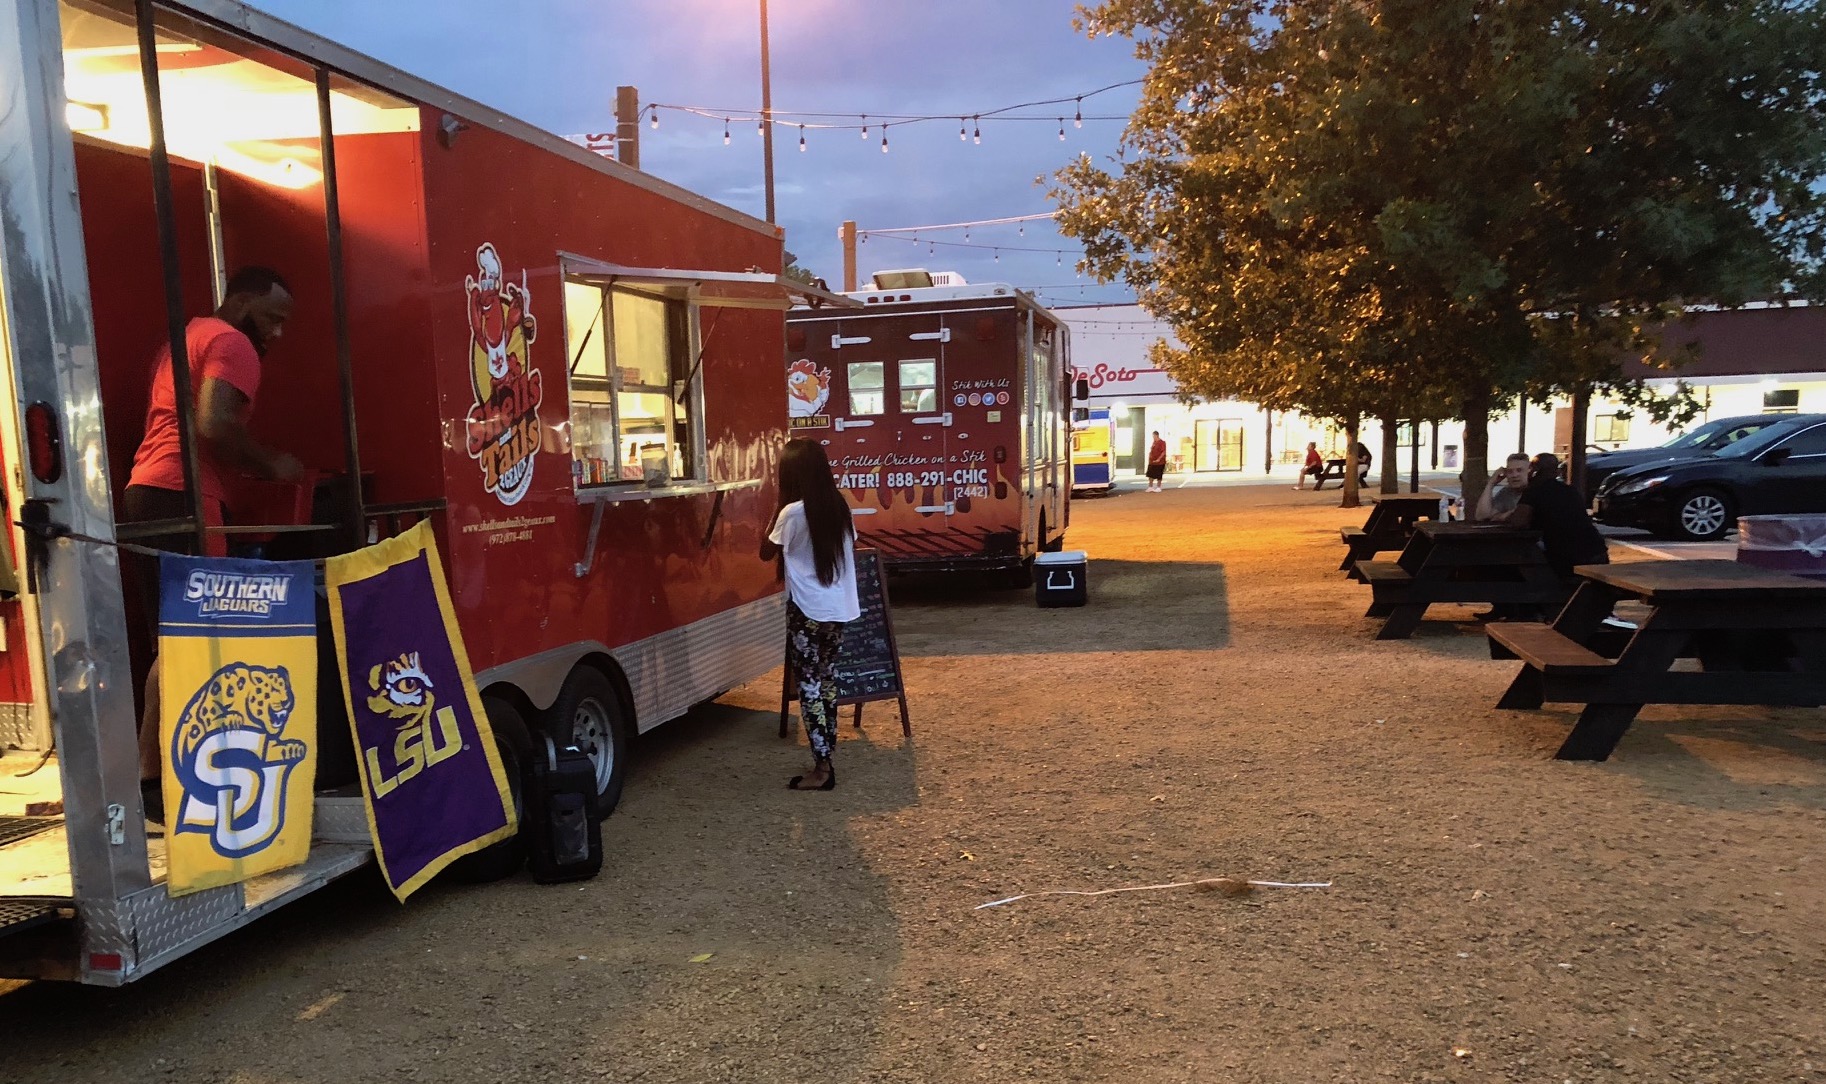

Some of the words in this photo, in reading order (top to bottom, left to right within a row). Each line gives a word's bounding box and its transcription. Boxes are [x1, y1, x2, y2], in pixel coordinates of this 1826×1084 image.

[952, 380, 972, 390] Stik
[975, 379, 996, 388] With
[469, 374, 541, 453] Shells
[482, 418, 540, 488] Tails
[841, 455, 882, 468] Grilled
[882, 452, 929, 467] Chicken
[931, 456, 945, 464] on
[949, 455, 958, 463] a
[960, 449, 987, 463] Stik
[833, 473, 880, 488] CATER!
[887, 469, 987, 487] 888-291-CHIC
[953, 486, 988, 500] [2442]
[186, 570, 292, 602] SOUTHERN
[202, 598, 270, 614] JAGUARS
[366, 705, 463, 800] LSU
